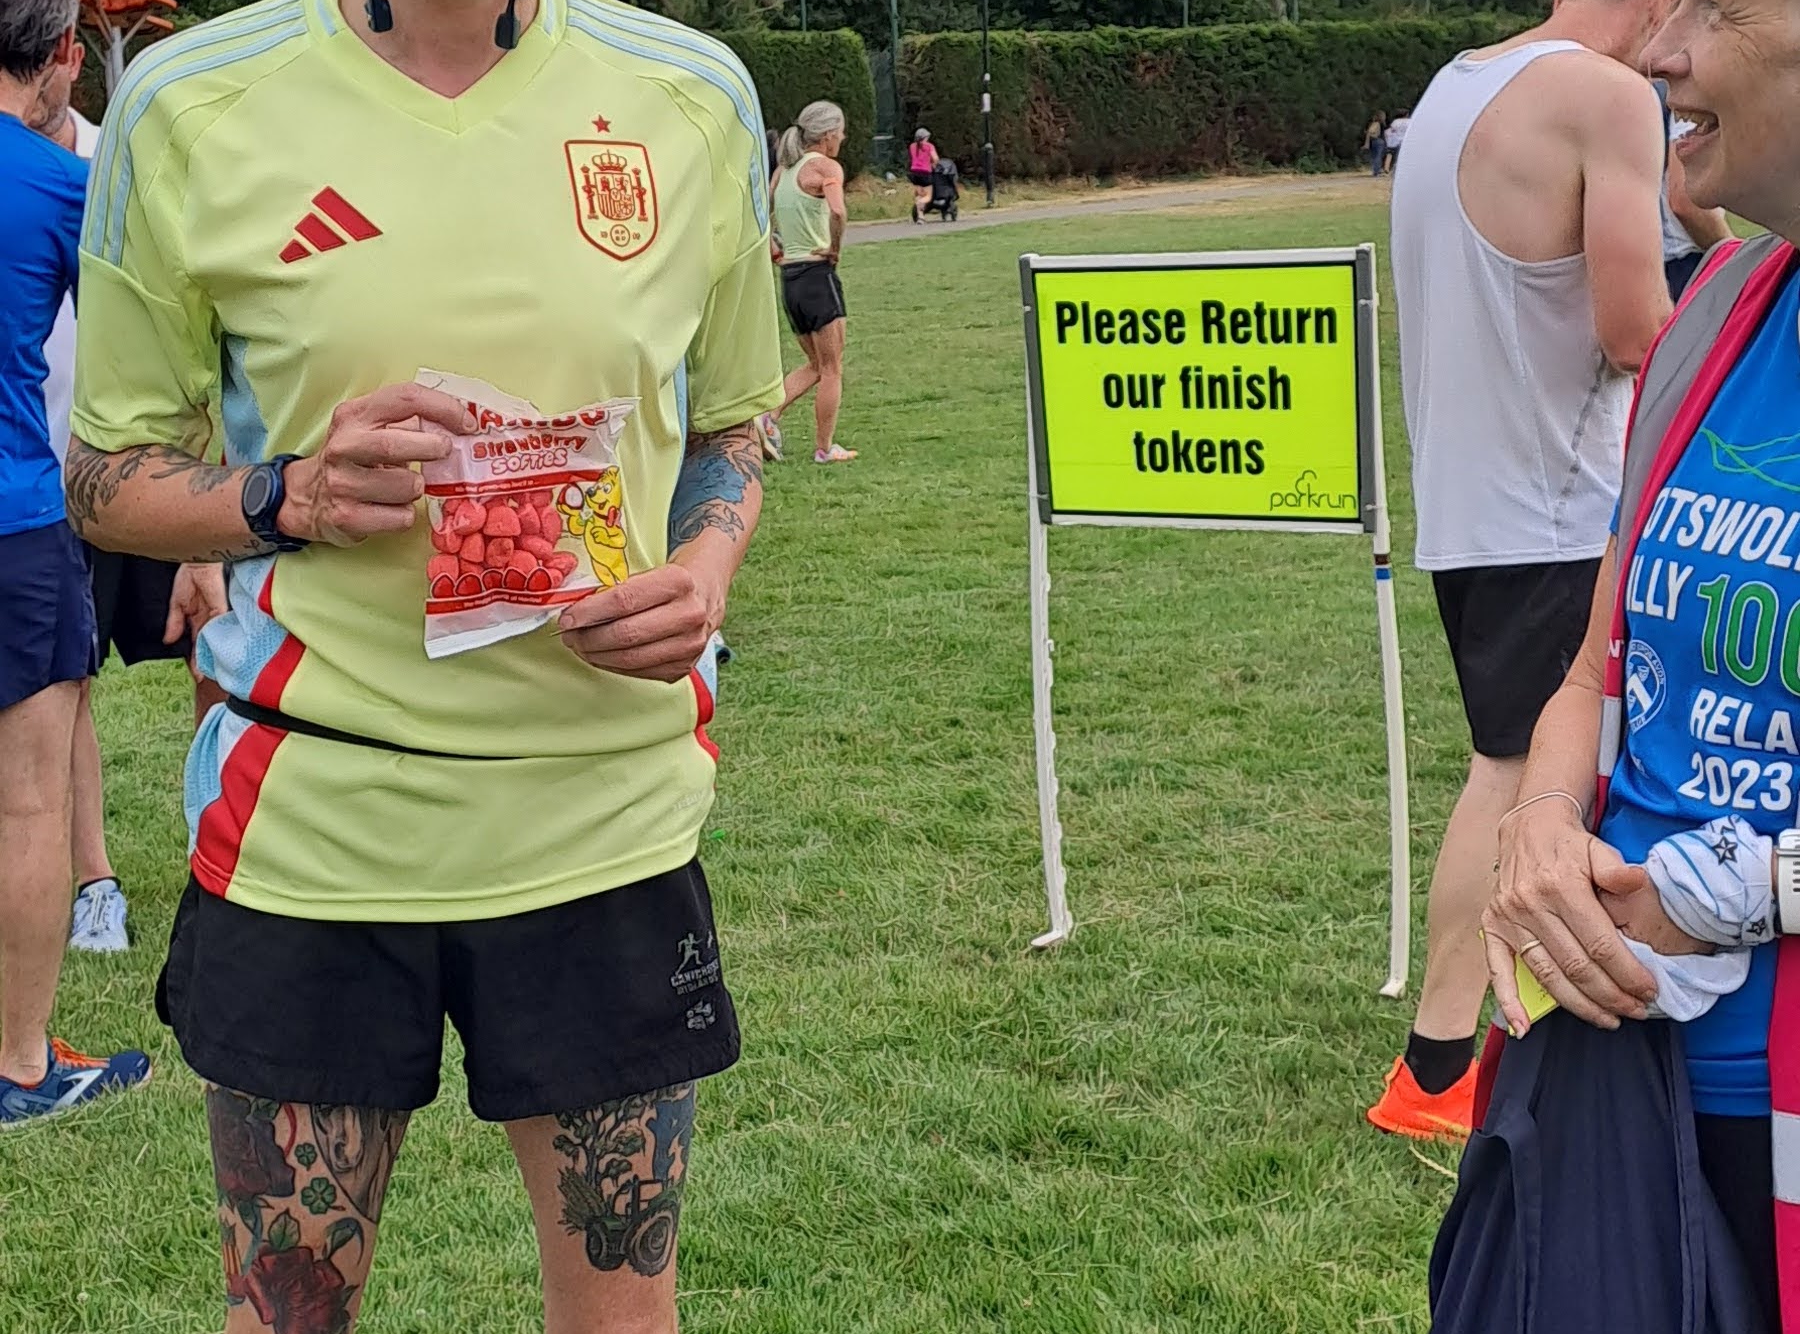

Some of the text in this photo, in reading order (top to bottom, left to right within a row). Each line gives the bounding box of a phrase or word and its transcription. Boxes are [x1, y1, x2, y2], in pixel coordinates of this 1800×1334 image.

[1055, 300, 1338, 345] Please Return
[1103, 365, 1292, 411] our finish
[1134, 430, 1265, 475] tokens
[1270, 481, 1356, 511] parkrun
[1690, 688, 1800, 756] RELA
[1676, 751, 1793, 811] 2023
